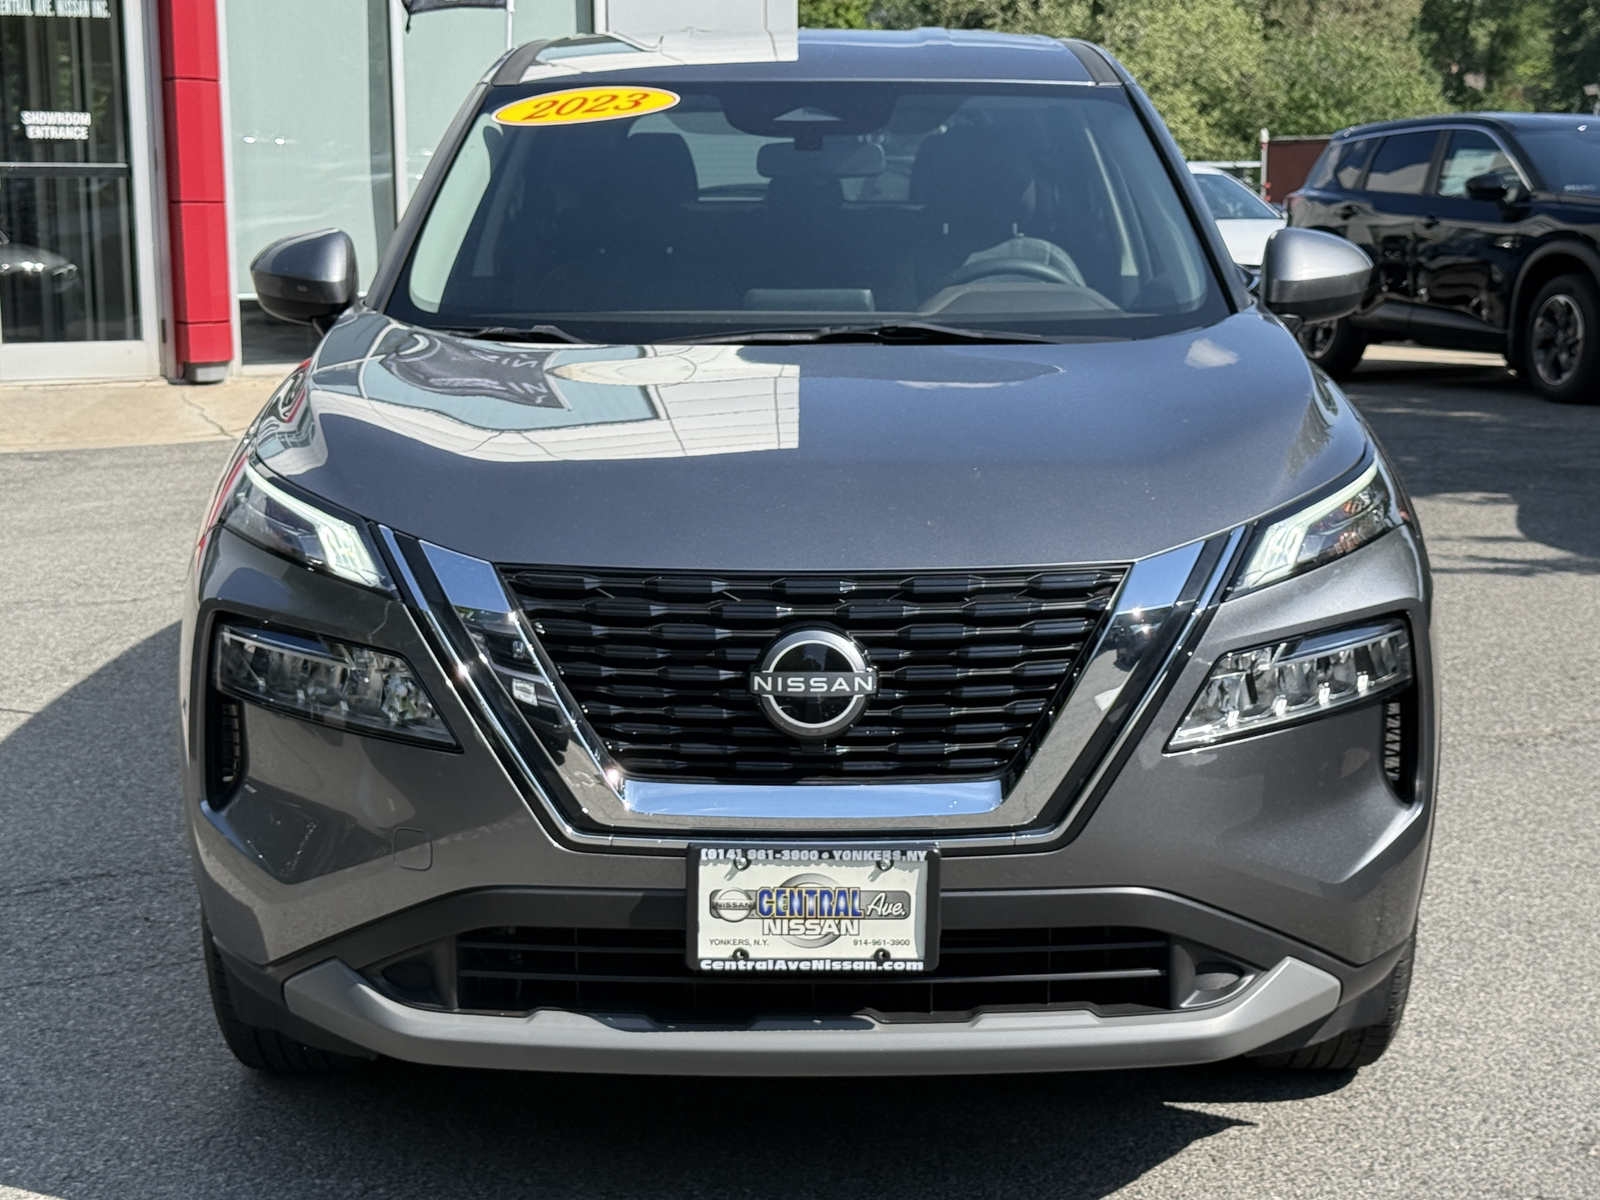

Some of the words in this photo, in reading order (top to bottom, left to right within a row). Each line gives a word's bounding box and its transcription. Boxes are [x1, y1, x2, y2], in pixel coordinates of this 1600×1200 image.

[0, 0, 33, 17] ENTRAL
[522, 92, 651, 121] 2023
[20, 110, 92, 126] SHOWROOM
[26, 125, 89, 140] ENTRANCE
[753, 675, 873, 692] NISSAN
[747, 849, 819, 861] 961-3900
[757, 887, 865, 918] CENTRAL
[866, 892, 907, 918] Ave.
[762, 918, 860, 936] NISSAN
[709, 938, 751, 947] YONKERS,
[753, 938, 770, 947] N.Y.
[700, 959, 924, 971] CentralAveNissan.com
